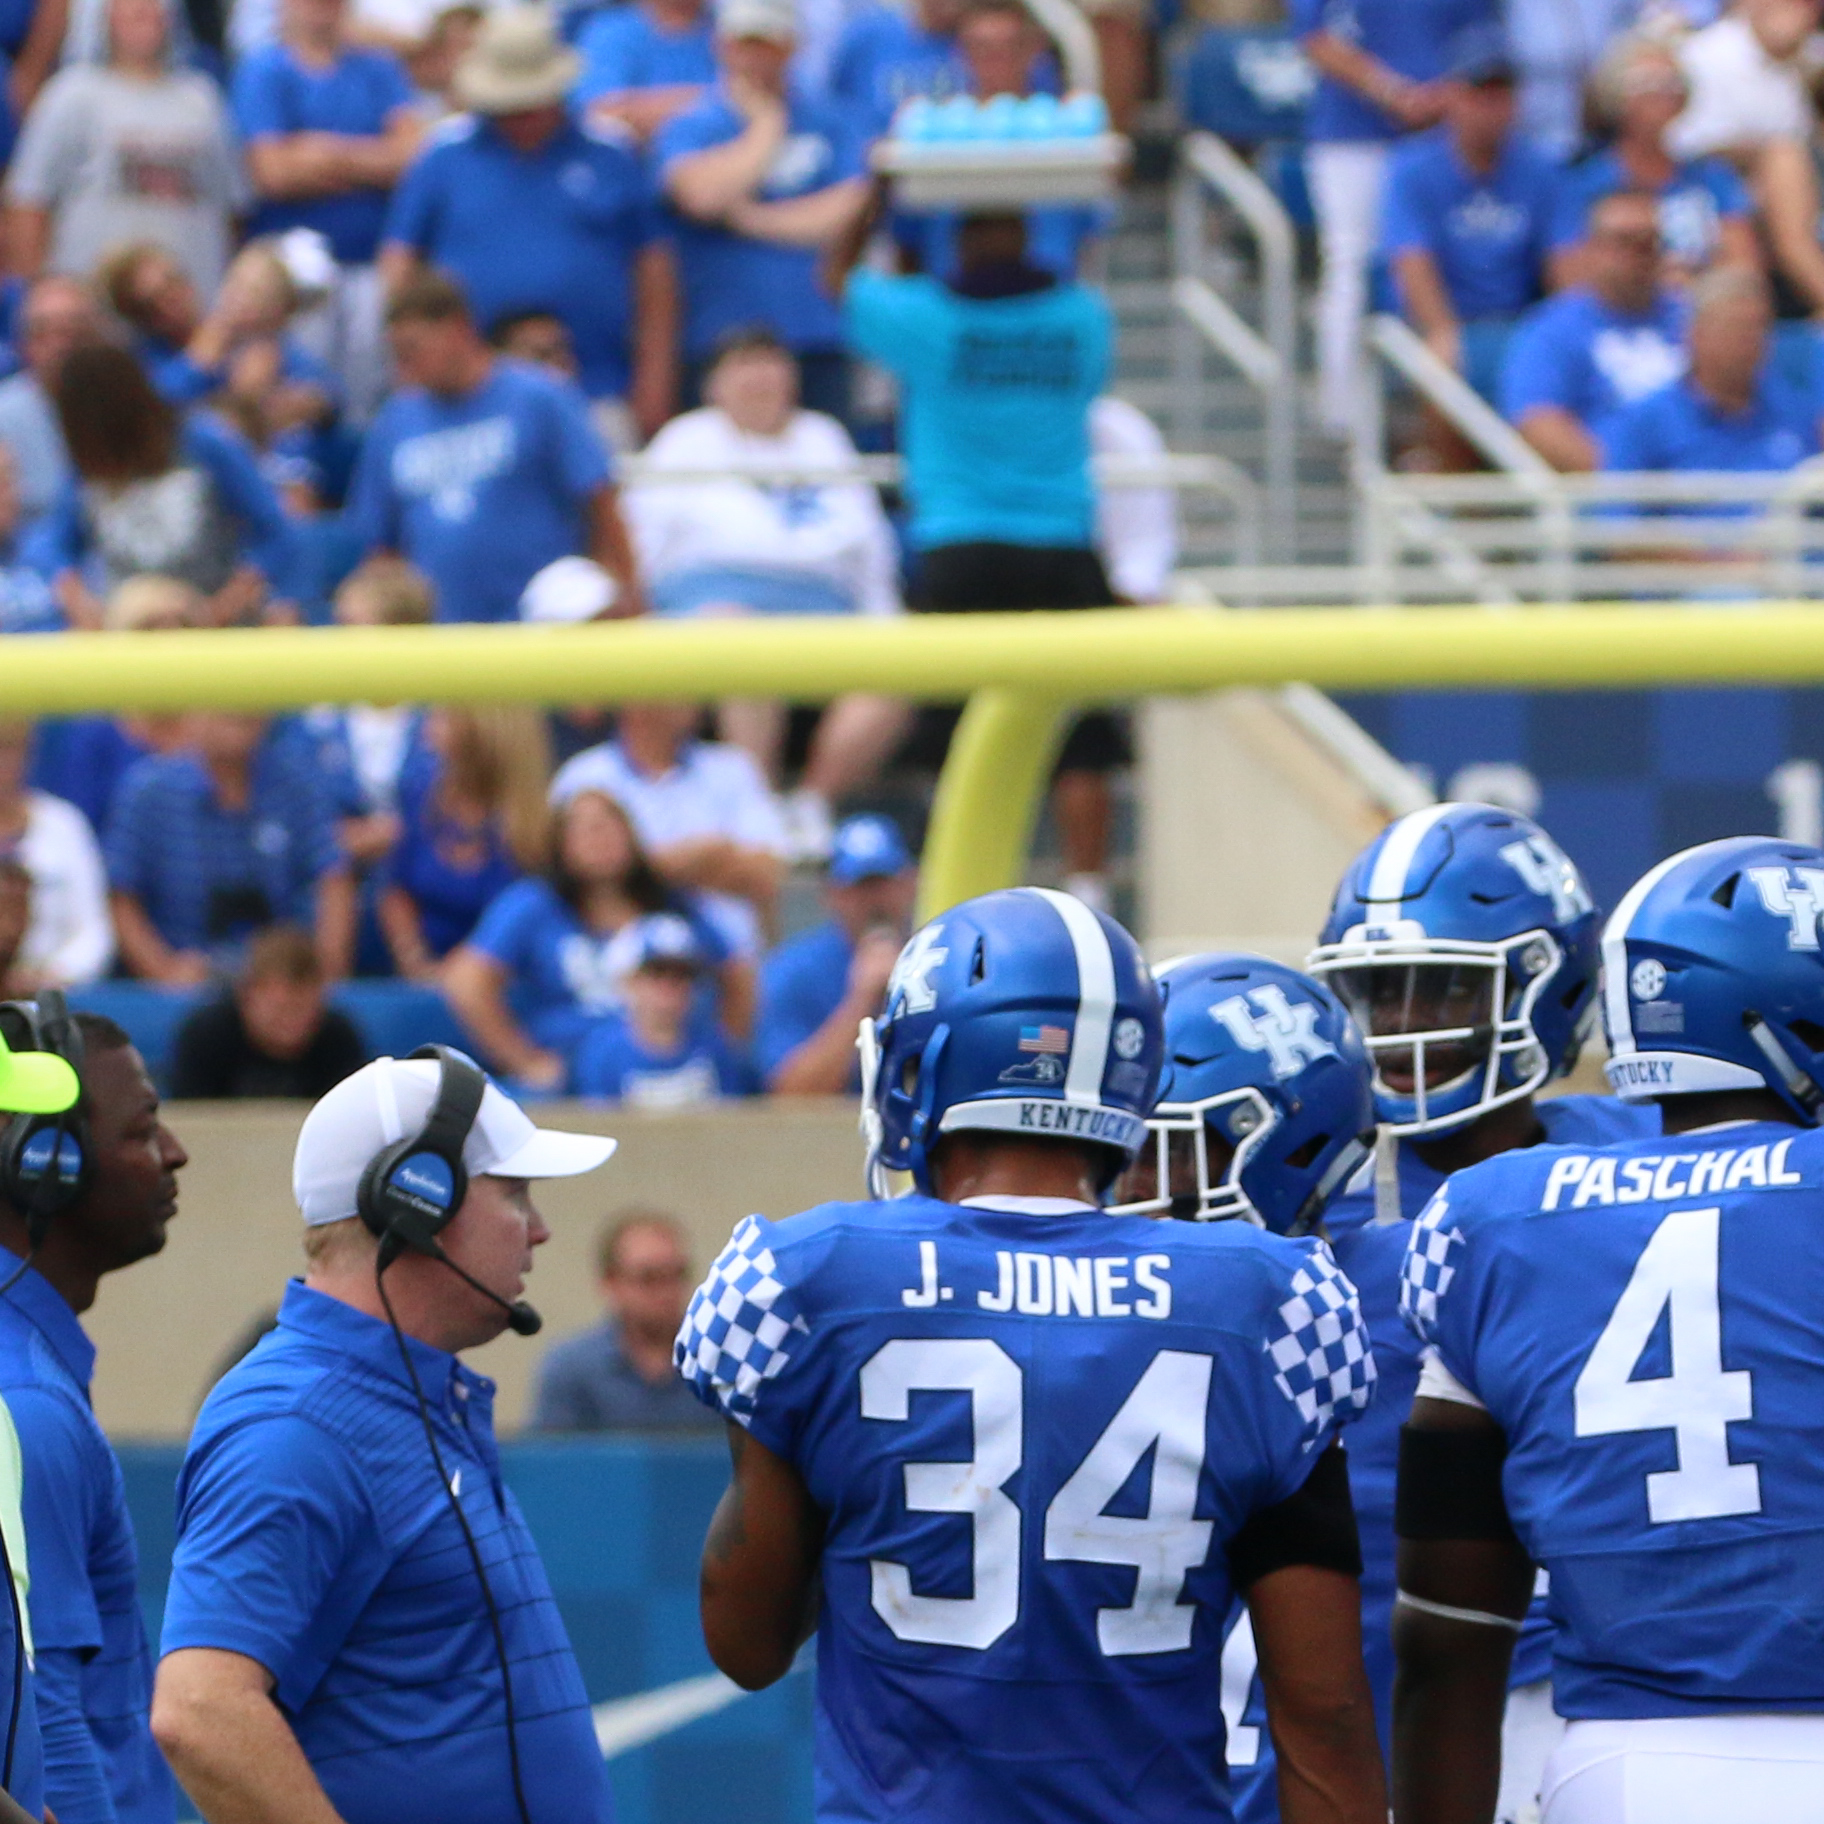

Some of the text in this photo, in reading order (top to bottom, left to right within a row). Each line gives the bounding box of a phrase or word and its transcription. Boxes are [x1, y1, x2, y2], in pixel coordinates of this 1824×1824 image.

[1207, 983, 1346, 1079] UK
[1540, 1137, 1801, 1211] PASCHAL
[902, 1240, 1173, 1319] J. JONES
[1574, 1207, 1762, 1525] 4
[859, 1338, 1214, 1657] 34
